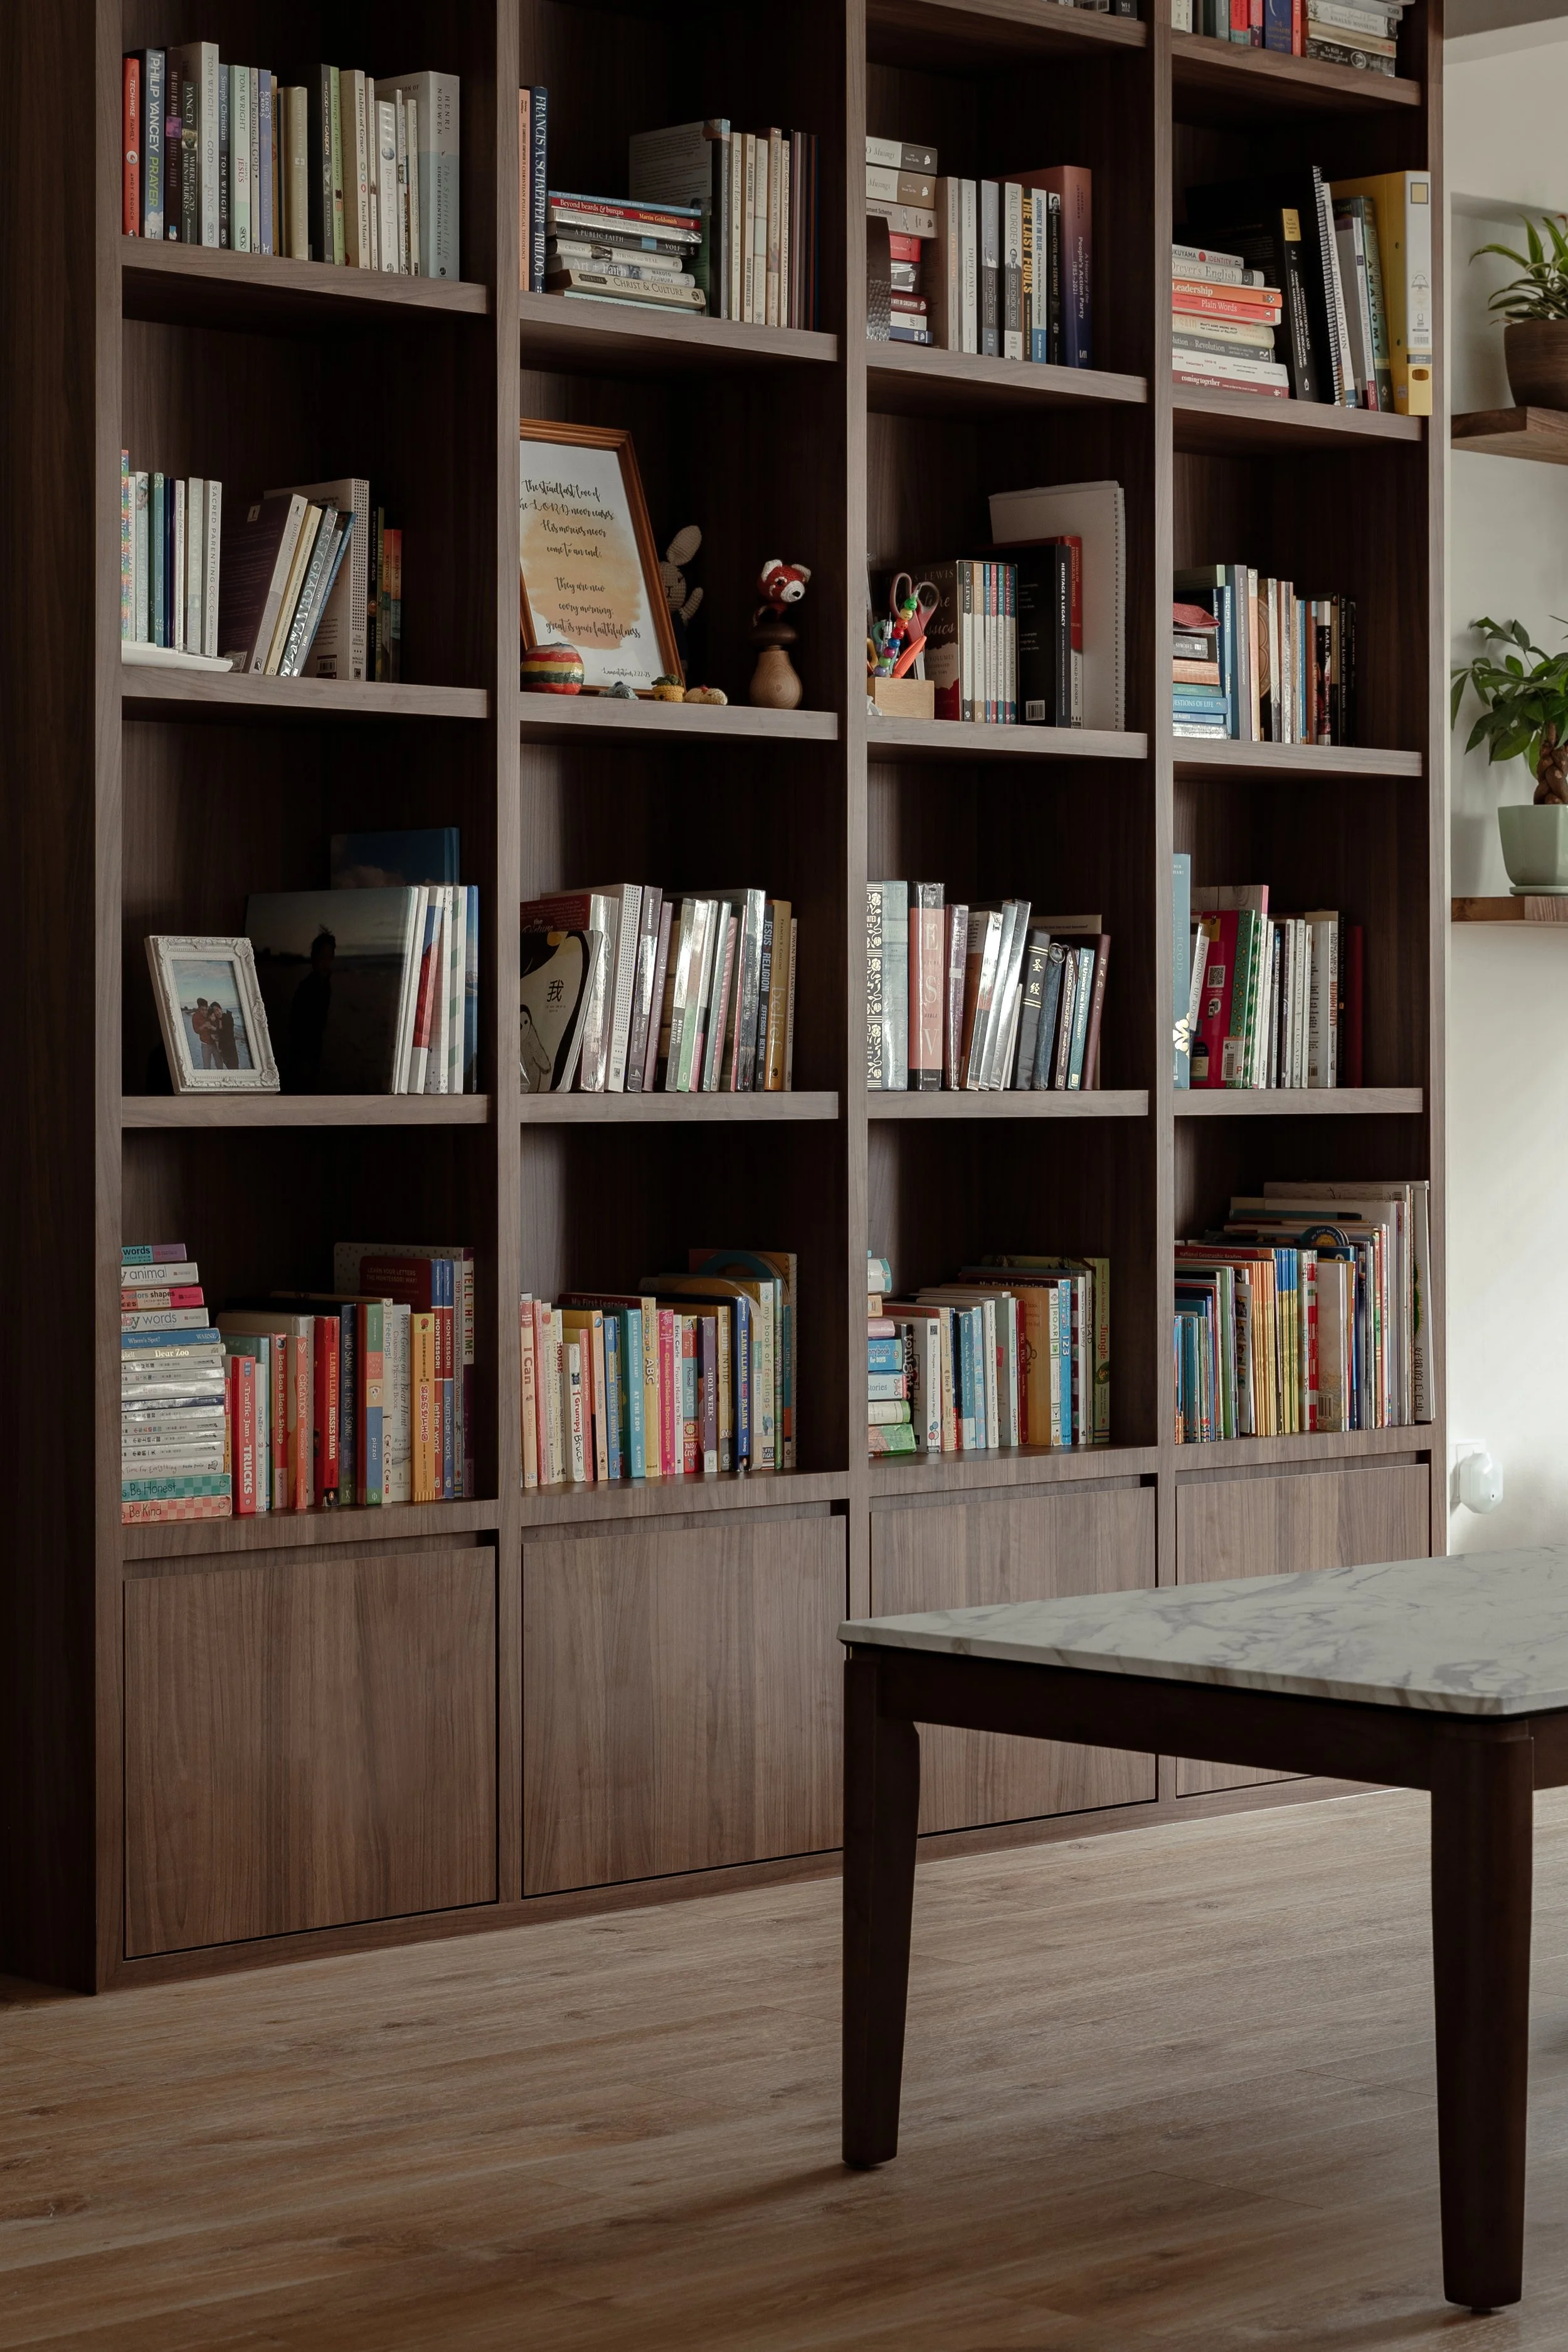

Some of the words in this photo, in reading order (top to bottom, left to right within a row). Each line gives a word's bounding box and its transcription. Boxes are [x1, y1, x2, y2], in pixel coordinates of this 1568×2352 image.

[149, 58, 160, 98] PHILIP
[149, 102, 159, 152] YANCEY
[535, 95, 546, 146] FRANCIS
[535, 148, 546, 158] A.
[149, 157, 159, 206] PRAYER
[535, 161, 546, 223] SCHAEFFER
[560, 199, 580, 209] Beyond
[581, 203, 598, 212] beards
[606, 207, 623, 216] burqas
[654, 215, 677, 225] Goldsmith
[1023, 198, 1032, 219] THE
[581, 230, 603, 239] PUBLIC
[605, 234, 623, 242] FAITH
[1010, 214, 1018, 245] ORDER
[1023, 224, 1032, 253] LAST
[534, 231, 546, 280] TRILOGY
[1023, 258, 1033, 294] FOOLS
[1205, 266, 1237, 282] English
[1172, 282, 1213, 296] Leadership
[1328, 233, 1337, 268] STROKE
[1333, 271, 1347, 349] REHABILITATION
[1201, 300, 1216, 309] Plain
[1218, 302, 1237, 312] Words
[1195, 339, 1225, 351] Revolution
[539, 480, 576, 499] steadfast
[576, 484, 591, 499] love
[593, 487, 600, 502] of
[520, 498, 528, 510] he
[763, 919, 773, 945] JESUS
[923, 923, 938, 950] E
[761, 953, 772, 992] RELIGION
[1195, 943, 1205, 983] BRINGING
[1029, 958, 1044, 995] 圣经
[547, 979, 564, 1002] 我
[924, 976, 937, 1003] S
[1194, 987, 1199, 998] UP
[1190, 1000, 1199, 1020] BOYS
[1330, 981, 1338, 1027] MEDIOCRITY
[769, 987, 787, 1051] belief
[923, 1029, 939, 1056] V
[123, 1246, 151, 1256] words
[129, 1266, 167, 1281] animal
[464, 1270, 473, 1298] TELL
[150, 1290, 175, 1299] shapes
[143, 1312, 177, 1324] words
[464, 1302, 473, 1322] THE
[344, 1333, 352, 1348] WHO
[464, 1328, 473, 1355] TIME
[1098, 1324, 1108, 1359] Jungle
[344, 1352, 352, 1372] SANG
[646, 1359, 655, 1384] ABC
[903, 1333, 914, 1387] tonight
[344, 1375, 352, 1389] THE
[344, 1392, 352, 1413] FIRST
[573, 1398, 581, 1433] Grumpy
[344, 1416, 353, 1441] SONG?
[574, 1435, 583, 1463] Bruce
[243, 1444, 252, 1493] TRUCKS
[130, 1483, 142, 1496] Be
[144, 1482, 177, 1494] Honest
[129, 1505, 140, 1518] Be
[142, 1503, 162, 1516] Kind
